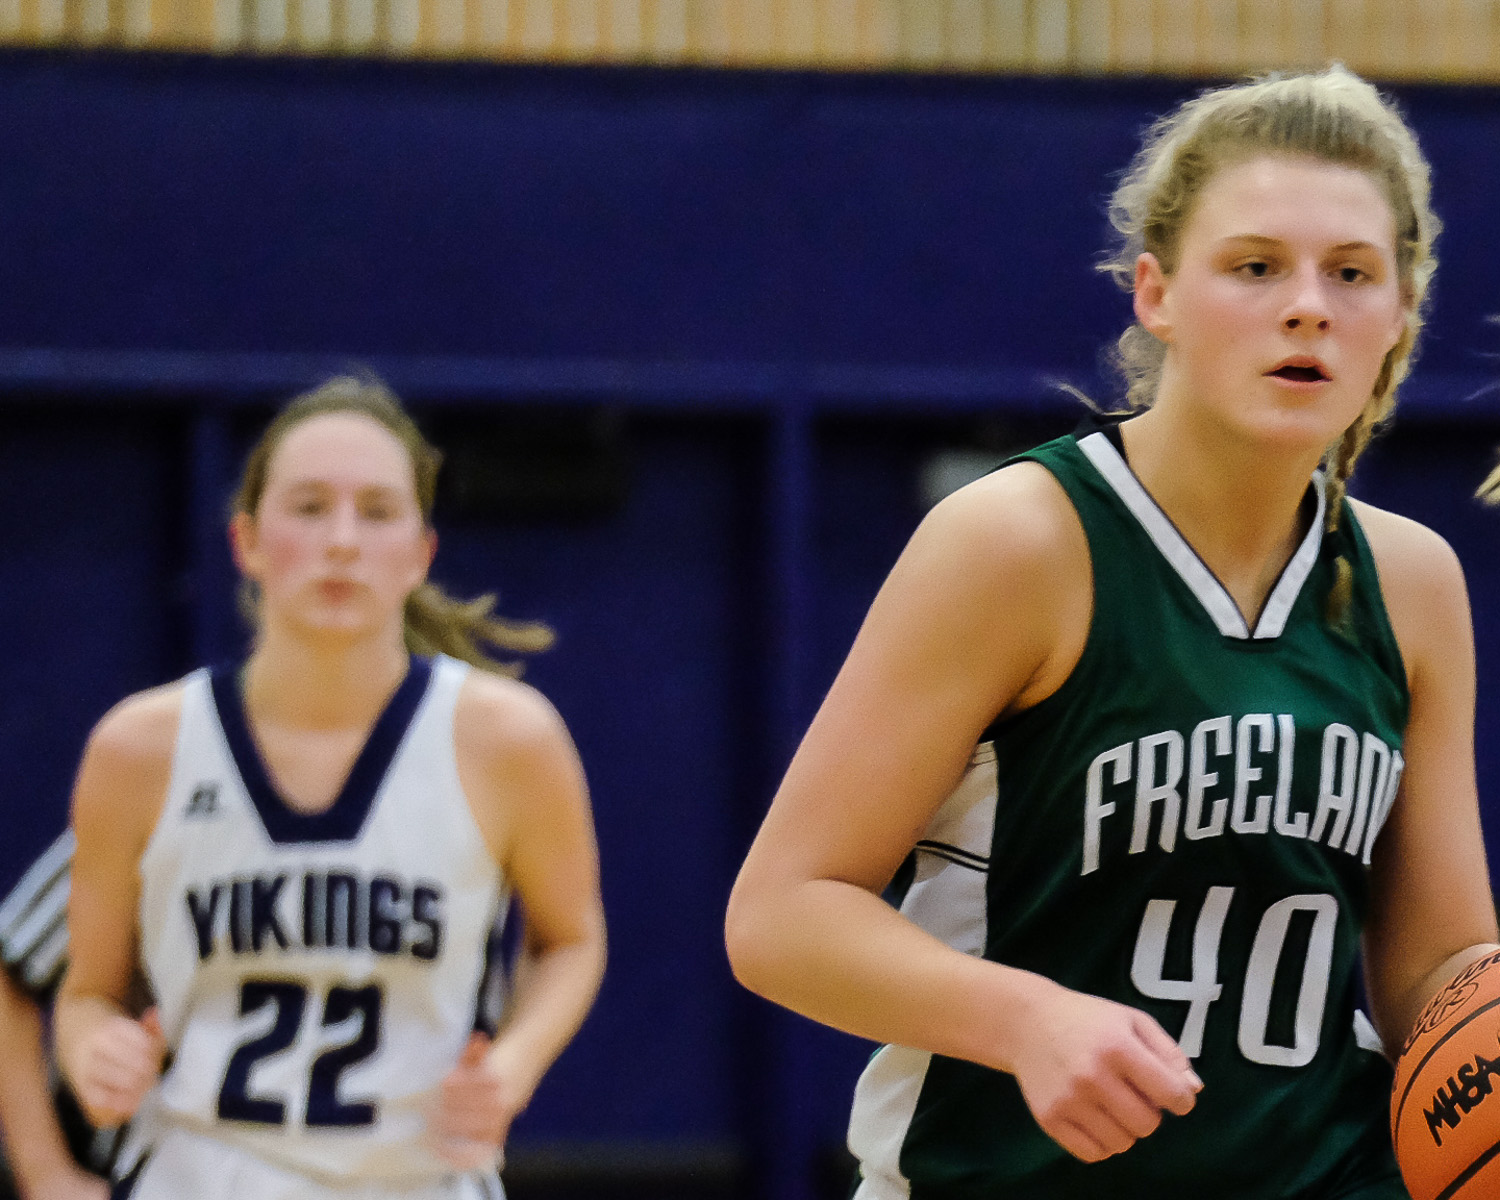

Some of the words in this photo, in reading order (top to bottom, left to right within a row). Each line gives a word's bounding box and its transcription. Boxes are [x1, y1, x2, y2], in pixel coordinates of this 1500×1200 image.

[187, 870, 443, 962] VIKINGS
[1130, 886, 1338, 1068] 40
[217, 980, 383, 1128] 22
